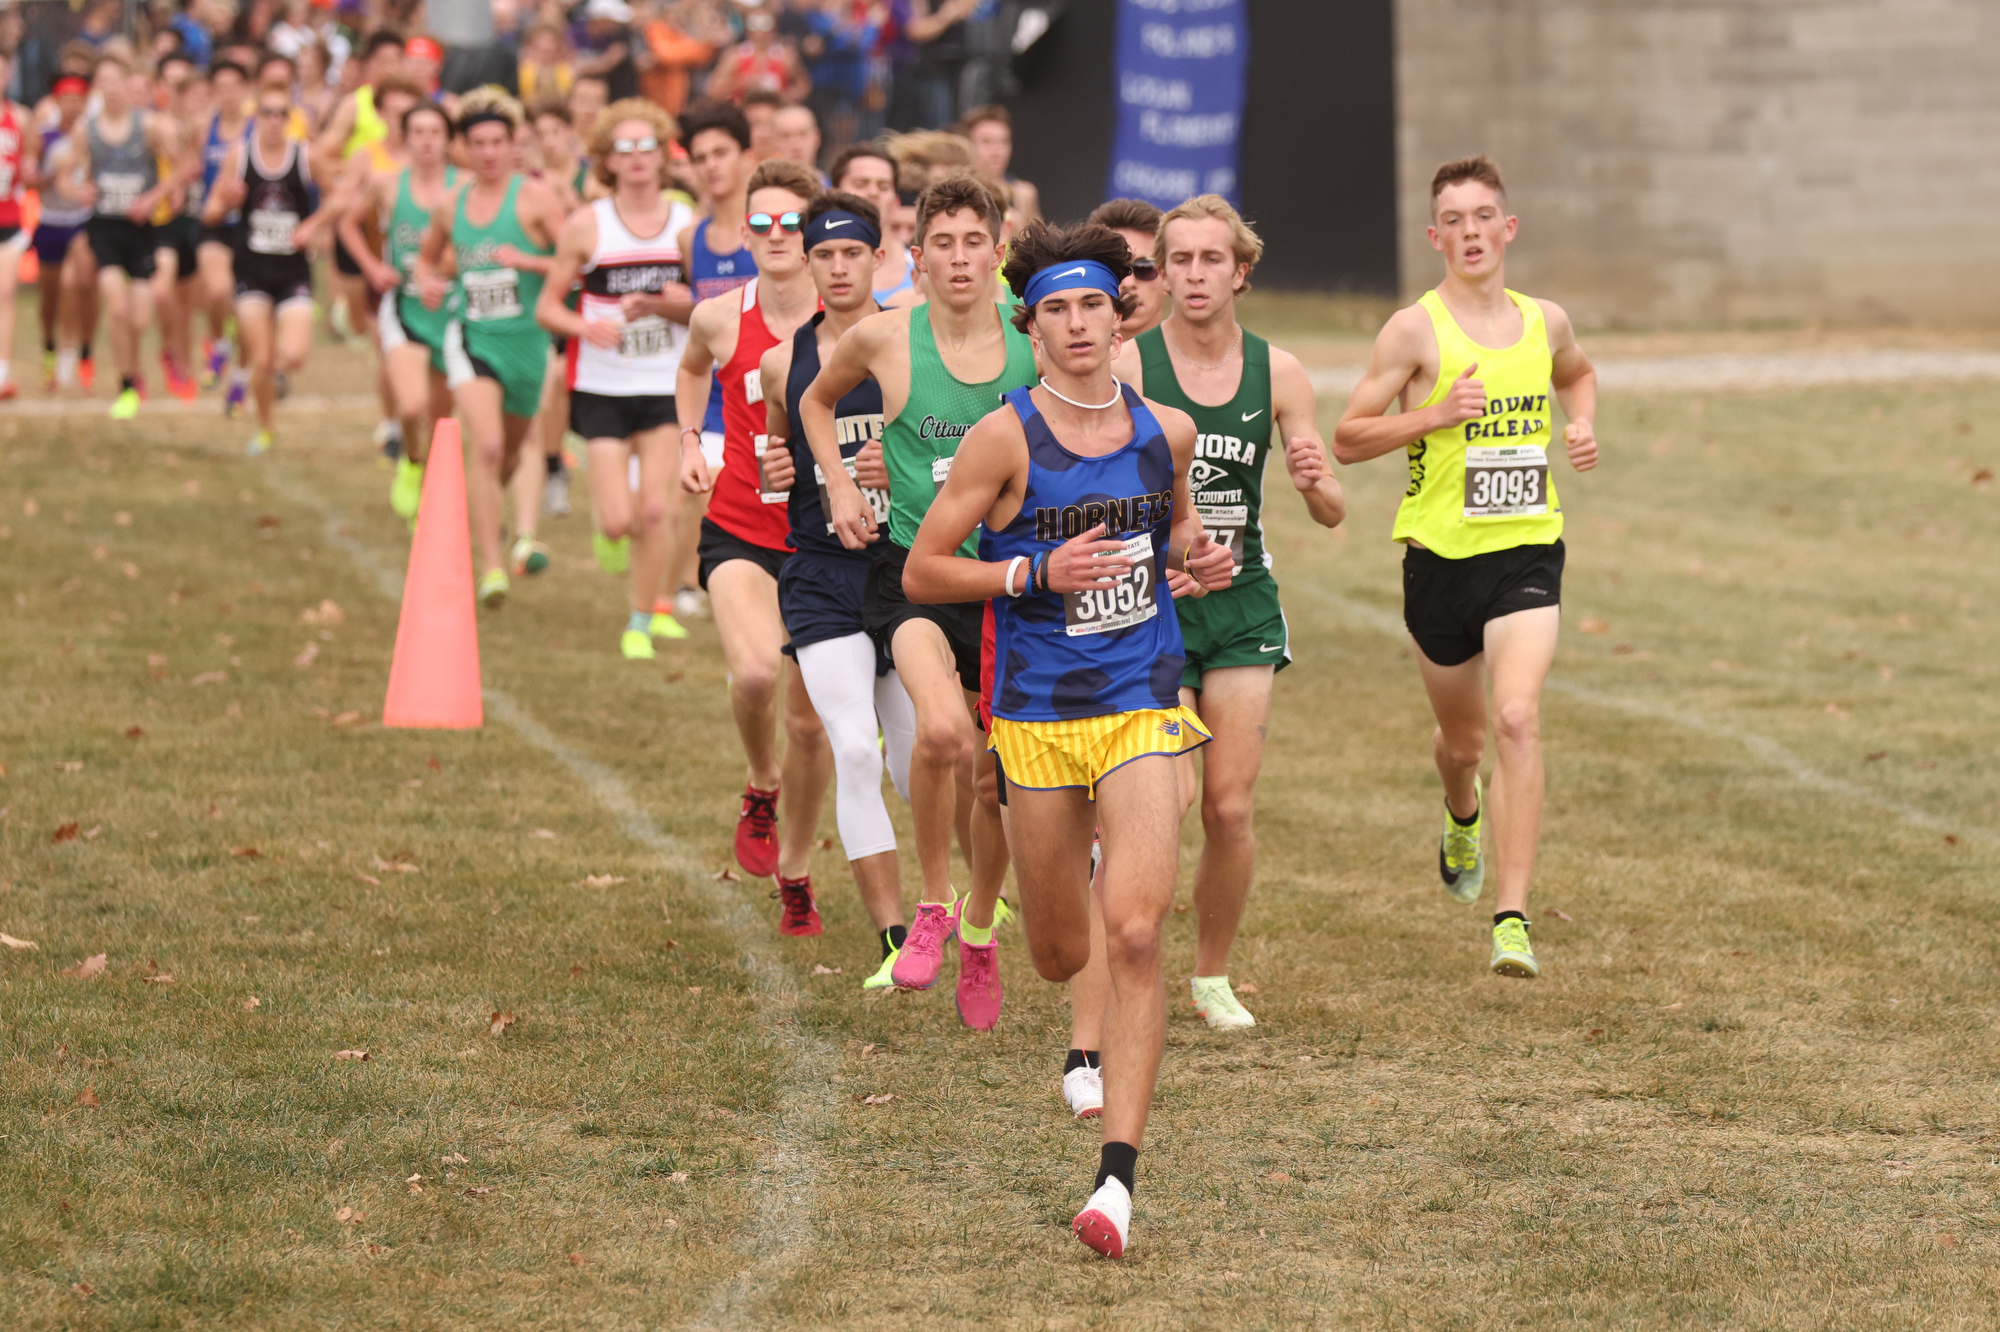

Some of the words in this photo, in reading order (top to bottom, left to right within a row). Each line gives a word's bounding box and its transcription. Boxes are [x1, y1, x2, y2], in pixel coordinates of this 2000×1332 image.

[1483, 395, 1547, 417] OUNT
[1465, 419, 1544, 441] GILEAD
[1194, 433, 1257, 467] NORA
[1196, 488, 1243, 504] COUNTRY
[1472, 468, 1540, 505] 3093
[1035, 489, 1173, 541] HORNETS
[1073, 565, 1152, 620] 3052
